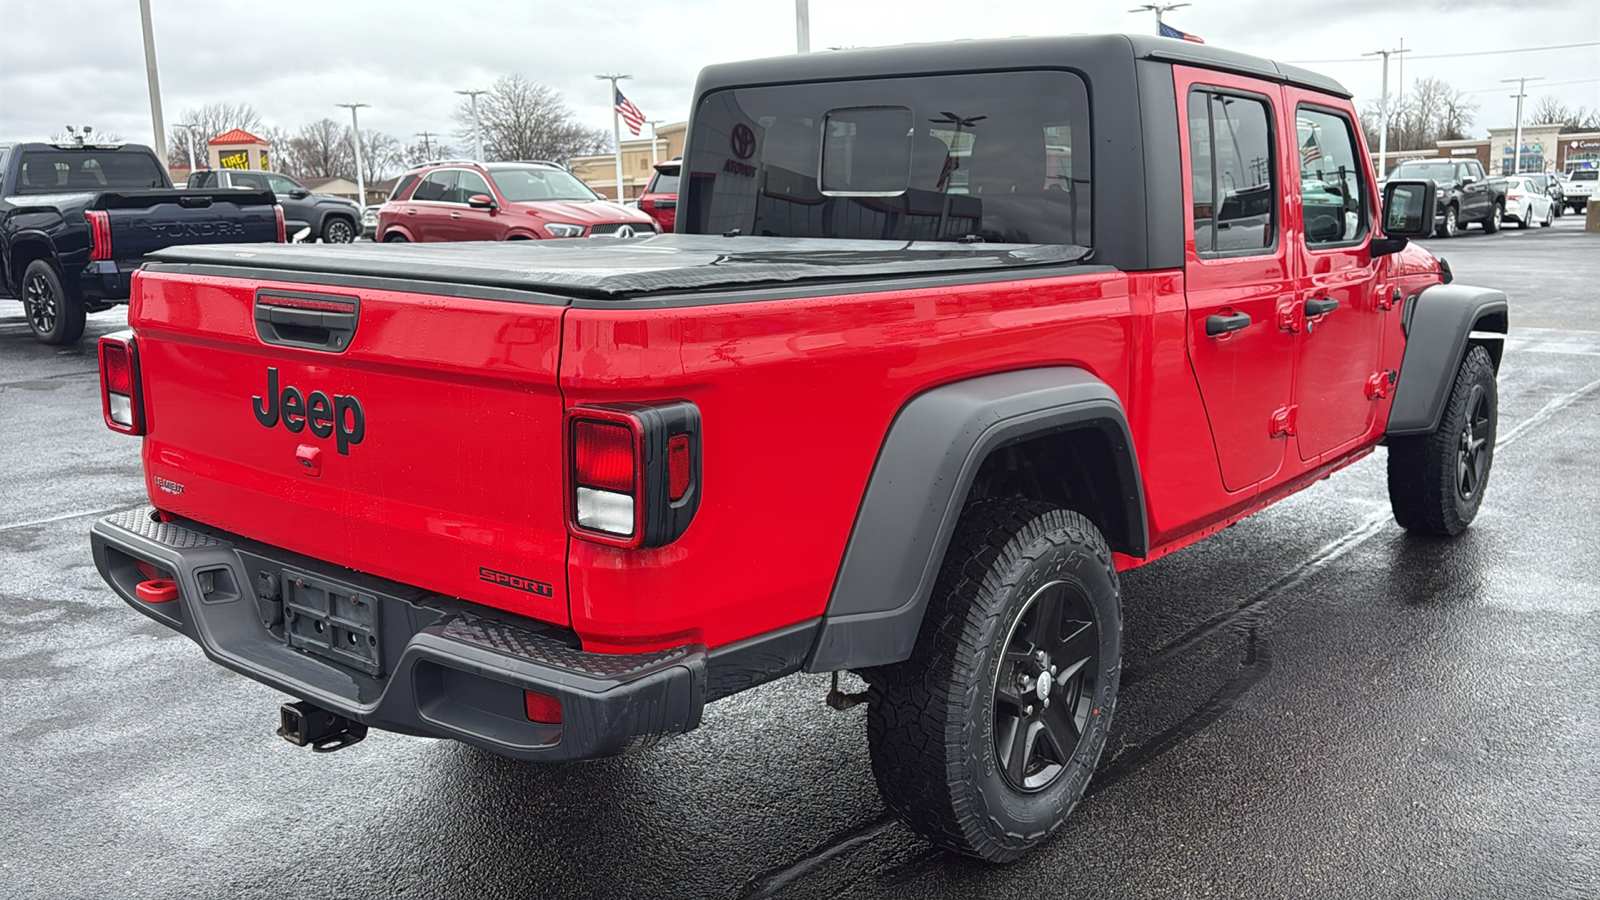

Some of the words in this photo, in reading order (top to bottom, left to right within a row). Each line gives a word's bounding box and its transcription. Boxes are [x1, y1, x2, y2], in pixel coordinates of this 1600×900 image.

[221, 152, 247, 168] TIRES
[149, 221, 246, 238] TUNDRA
[252, 366, 365, 456] Jeep
[480, 567, 553, 597] SPORT
